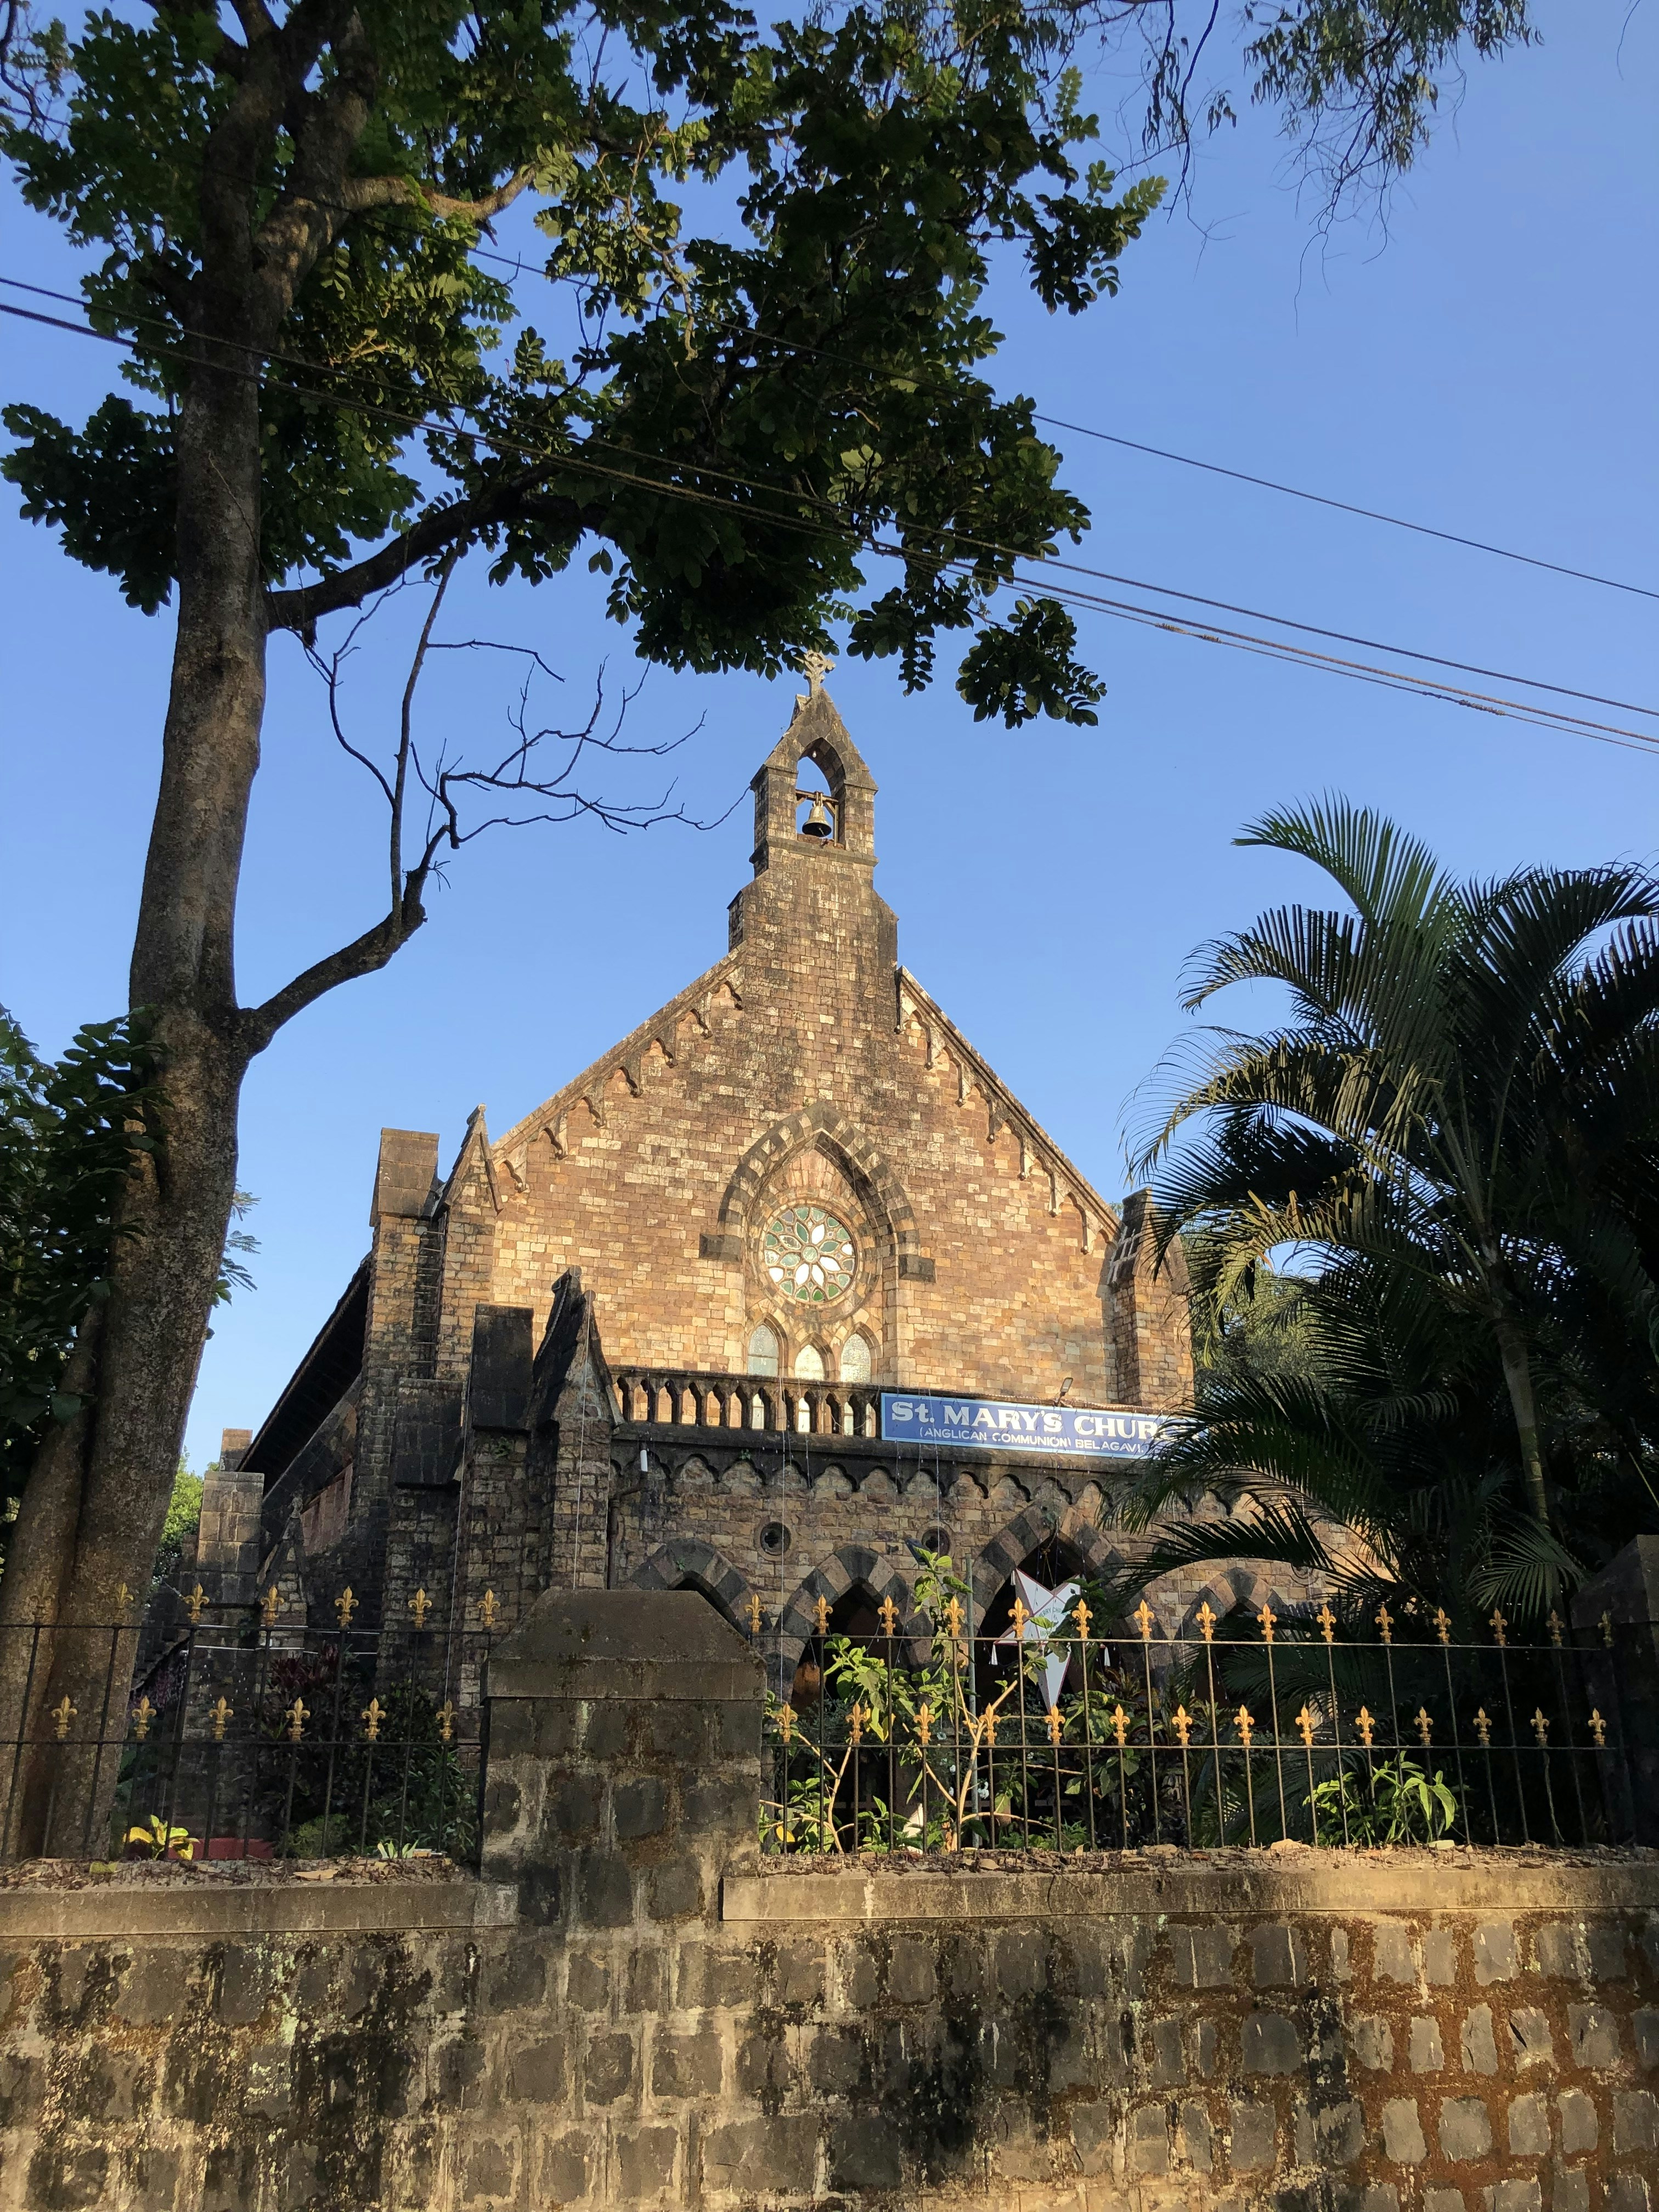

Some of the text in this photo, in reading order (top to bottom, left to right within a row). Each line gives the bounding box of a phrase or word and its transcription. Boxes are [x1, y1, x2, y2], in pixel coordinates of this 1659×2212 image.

[891, 1401, 1195, 1441] St. MARY'S CHUR
[919, 1426, 1144, 1453] (ANGLICAN COMMUNION) BELAGAVI.
